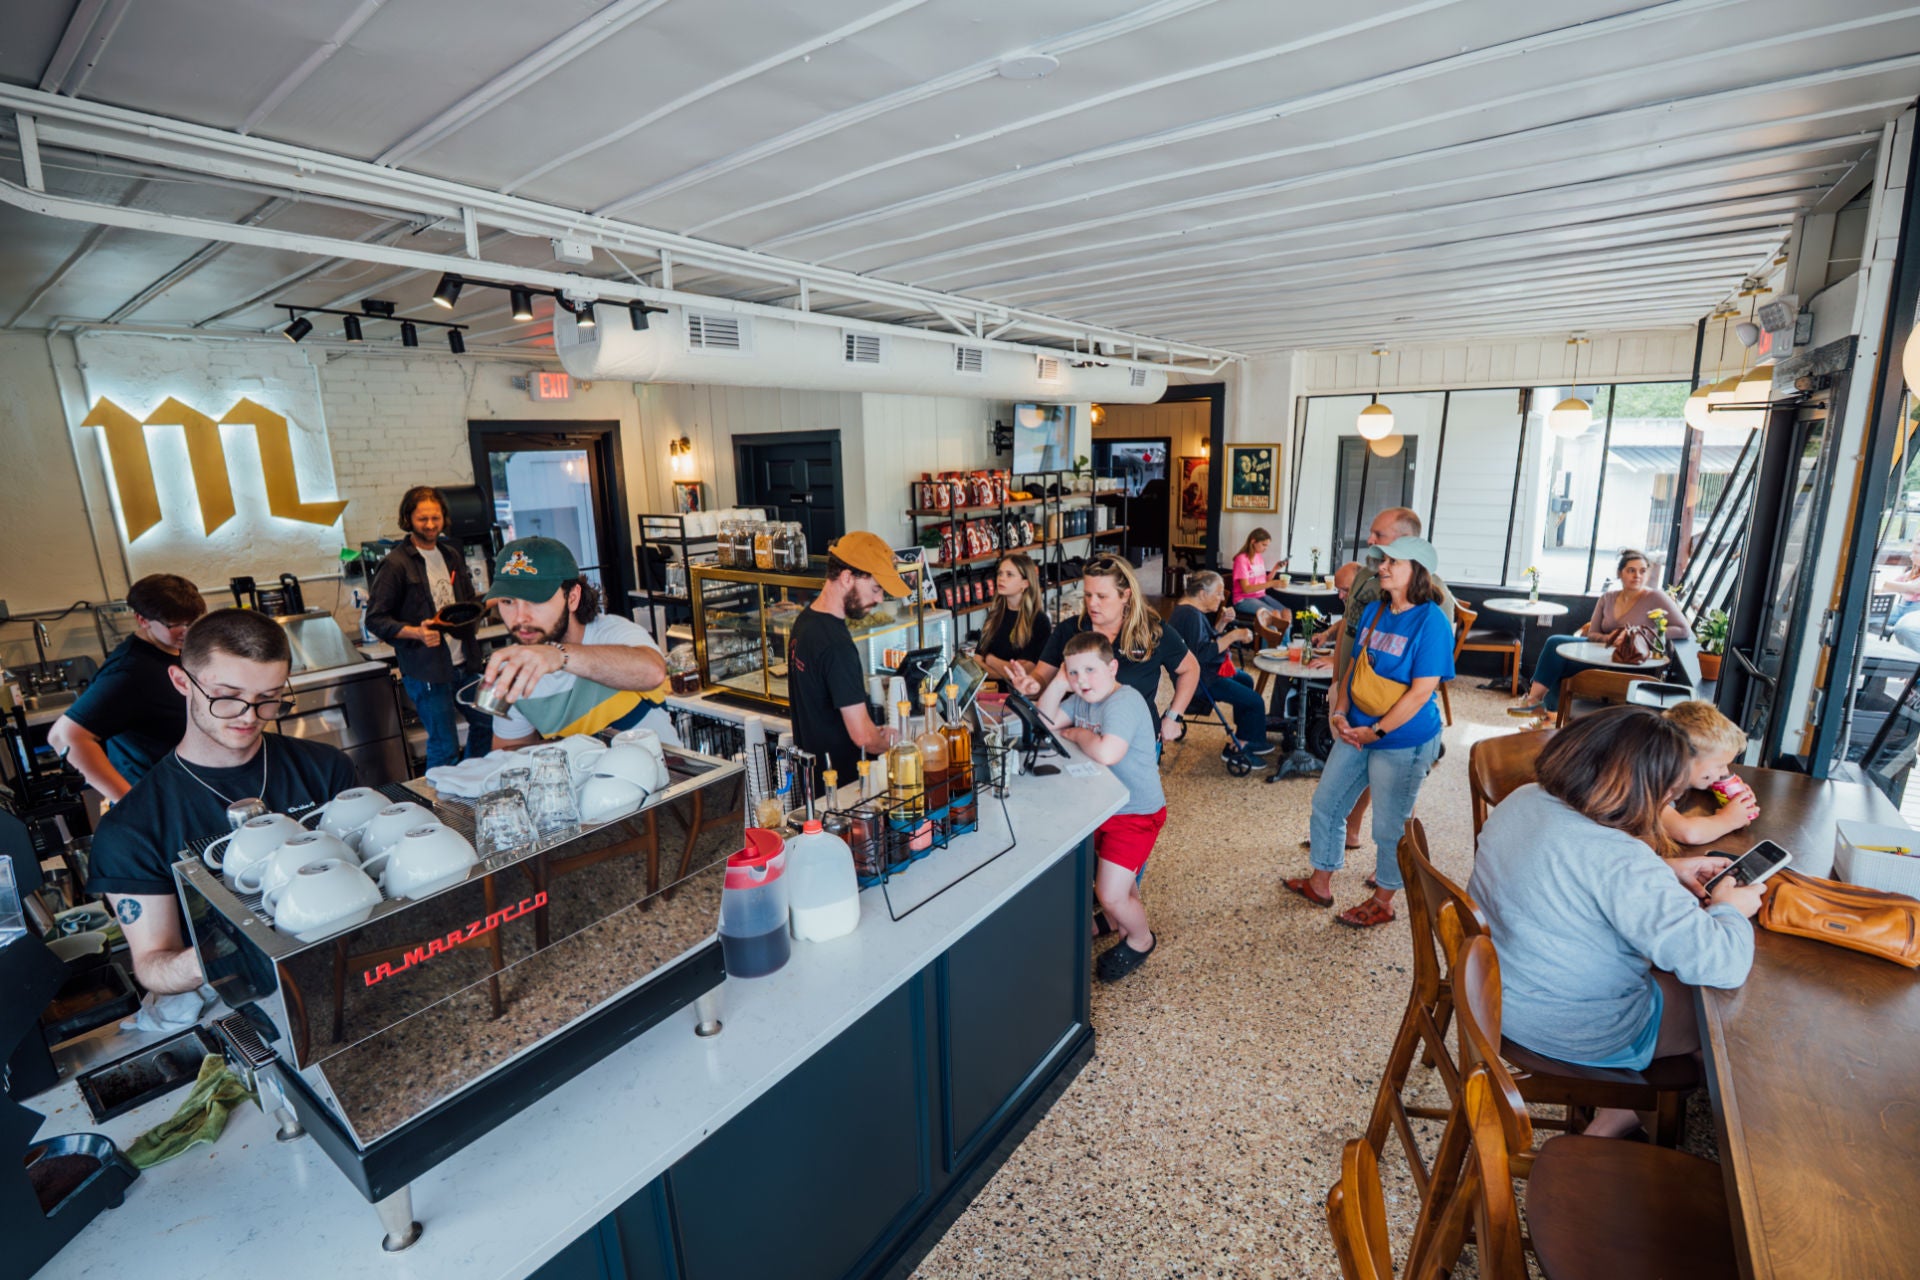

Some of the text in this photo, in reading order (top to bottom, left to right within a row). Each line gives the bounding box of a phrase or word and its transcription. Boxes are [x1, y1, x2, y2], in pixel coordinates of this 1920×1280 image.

[539, 373, 568, 398] EXIT
[364, 890, 549, 987] LA MARZOCCO
